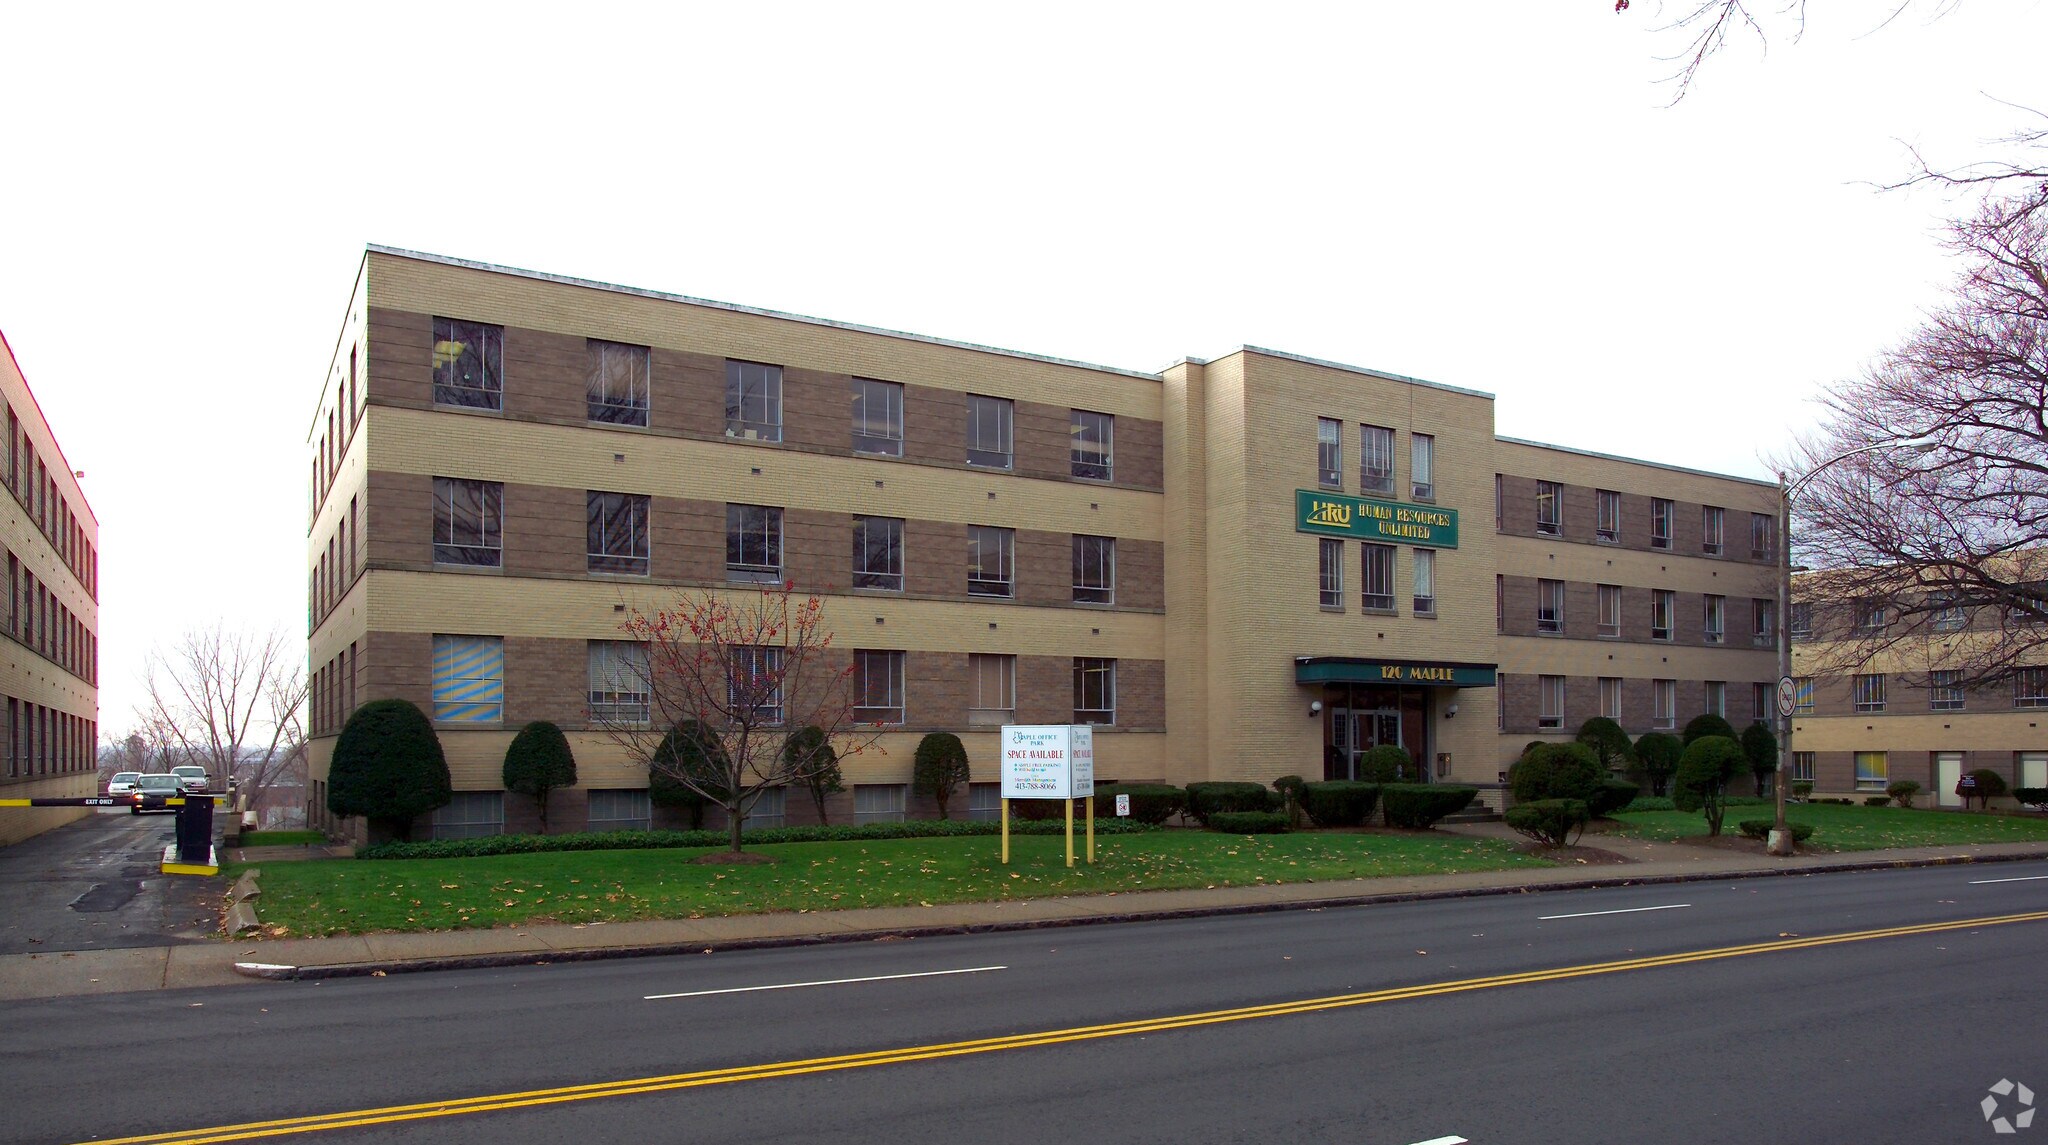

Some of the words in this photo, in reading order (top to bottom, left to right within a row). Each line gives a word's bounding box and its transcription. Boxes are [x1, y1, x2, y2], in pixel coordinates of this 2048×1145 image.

[1312, 501, 1350, 524] HRU
[1358, 503, 1392, 519] HUMAN
[1397, 508, 1450, 527] RESOURCES
[1379, 521, 1430, 539] UNLIMITED
[1381, 665, 1403, 679] 120
[1409, 667, 1454, 681] MAPLE
[1008, 750, 1027, 759] SPACE
[1029, 750, 1064, 759] AVAILABLE
